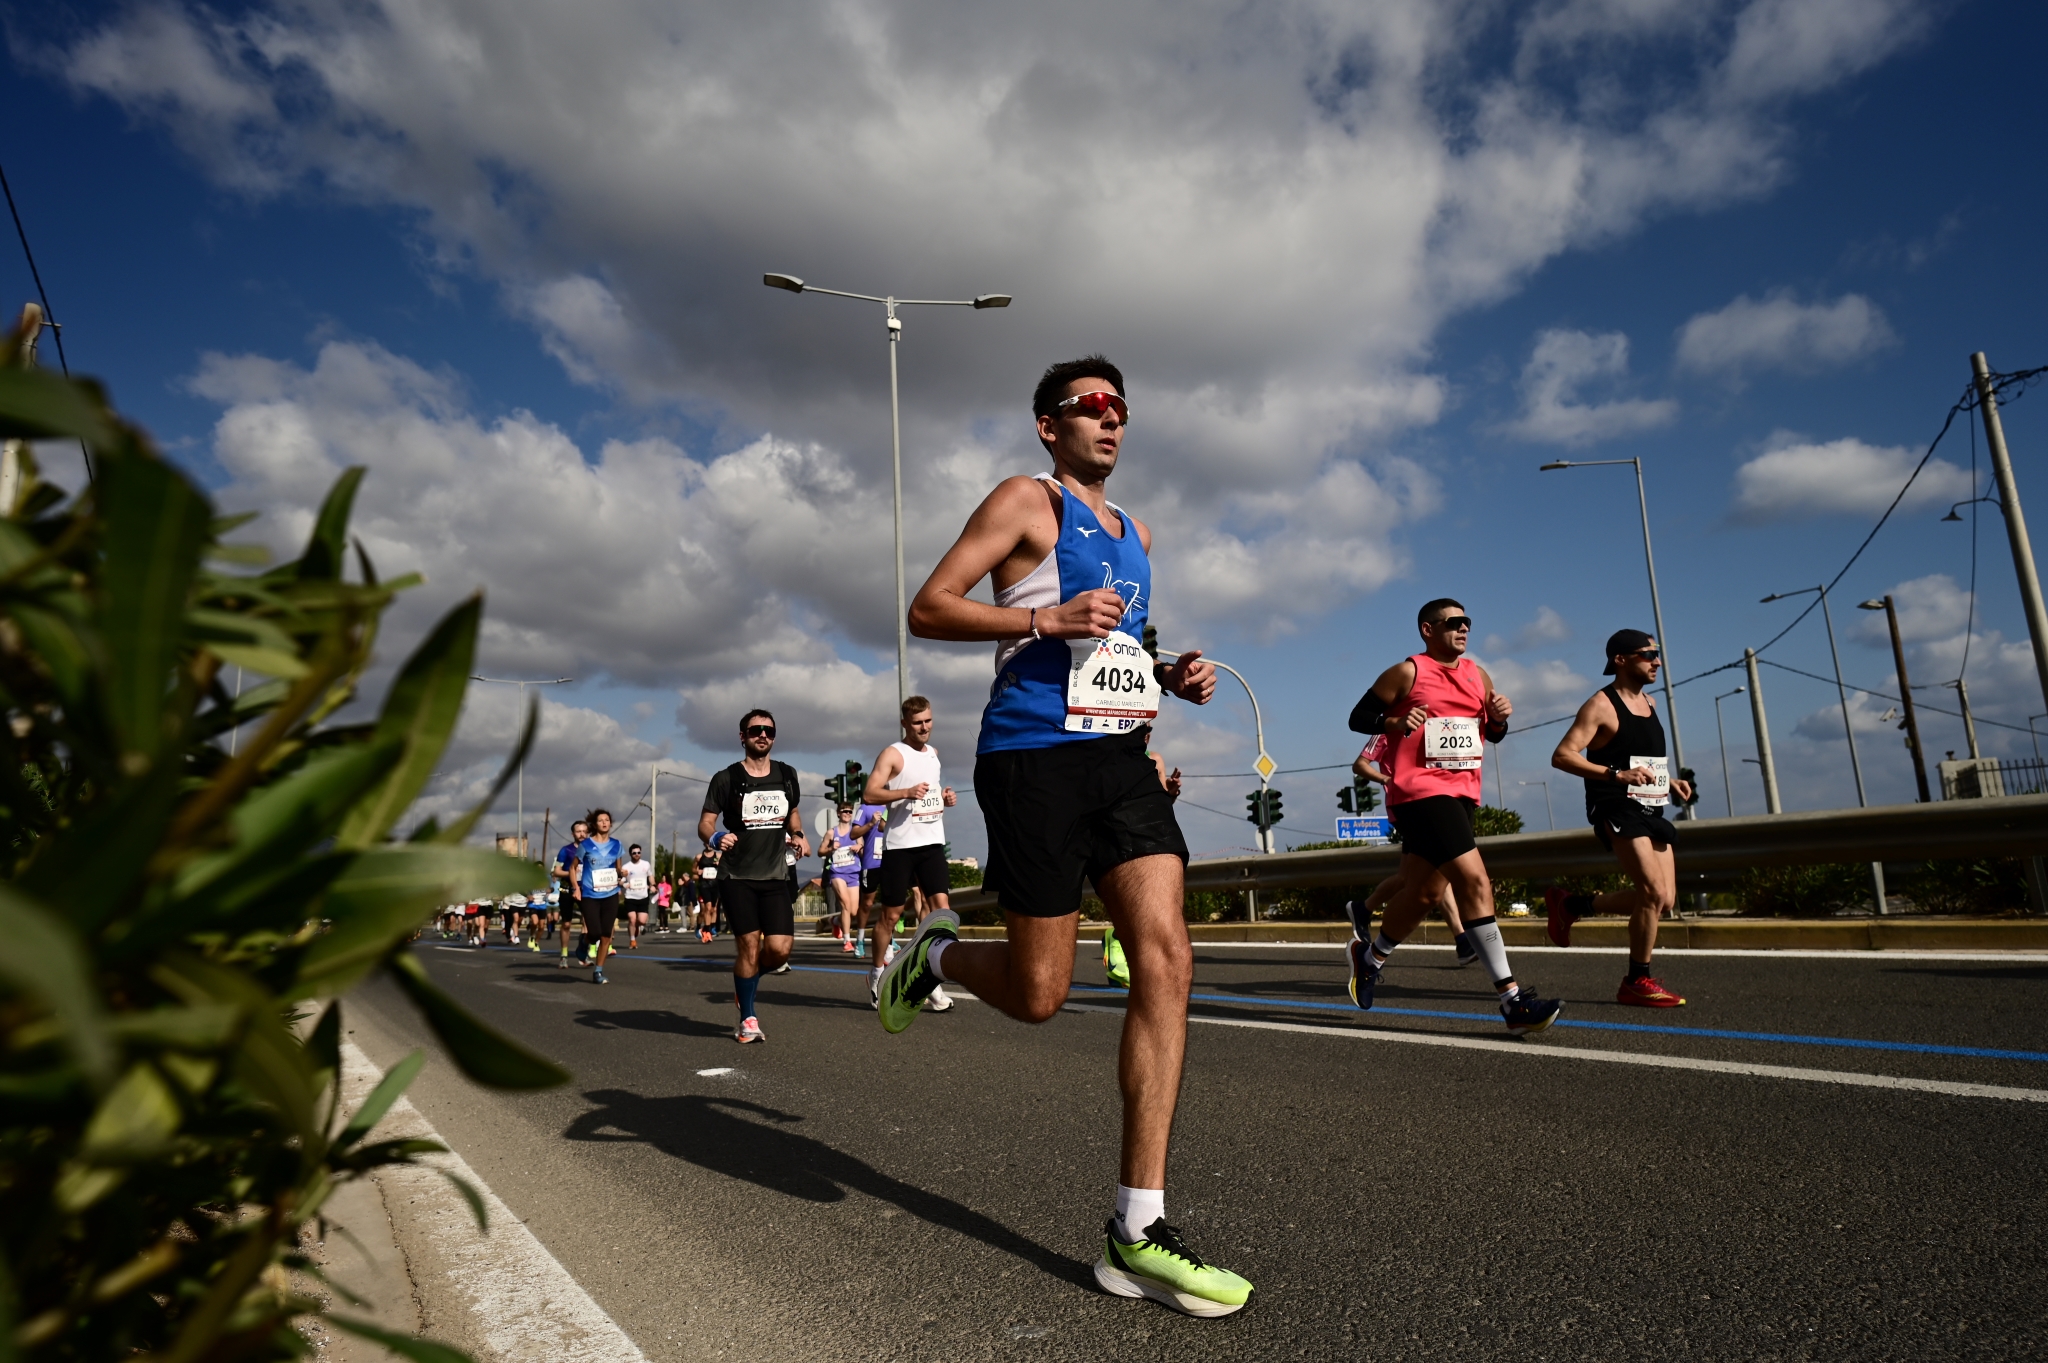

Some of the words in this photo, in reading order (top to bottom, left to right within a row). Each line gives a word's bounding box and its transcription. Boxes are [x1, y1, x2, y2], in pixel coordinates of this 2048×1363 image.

[1091, 666, 1146, 694] 4034
[1439, 735, 1473, 749] 2023
[921, 797, 940, 808] 3075
[753, 805, 780, 814] 3076
[1354, 828, 1381, 837] Andreas
